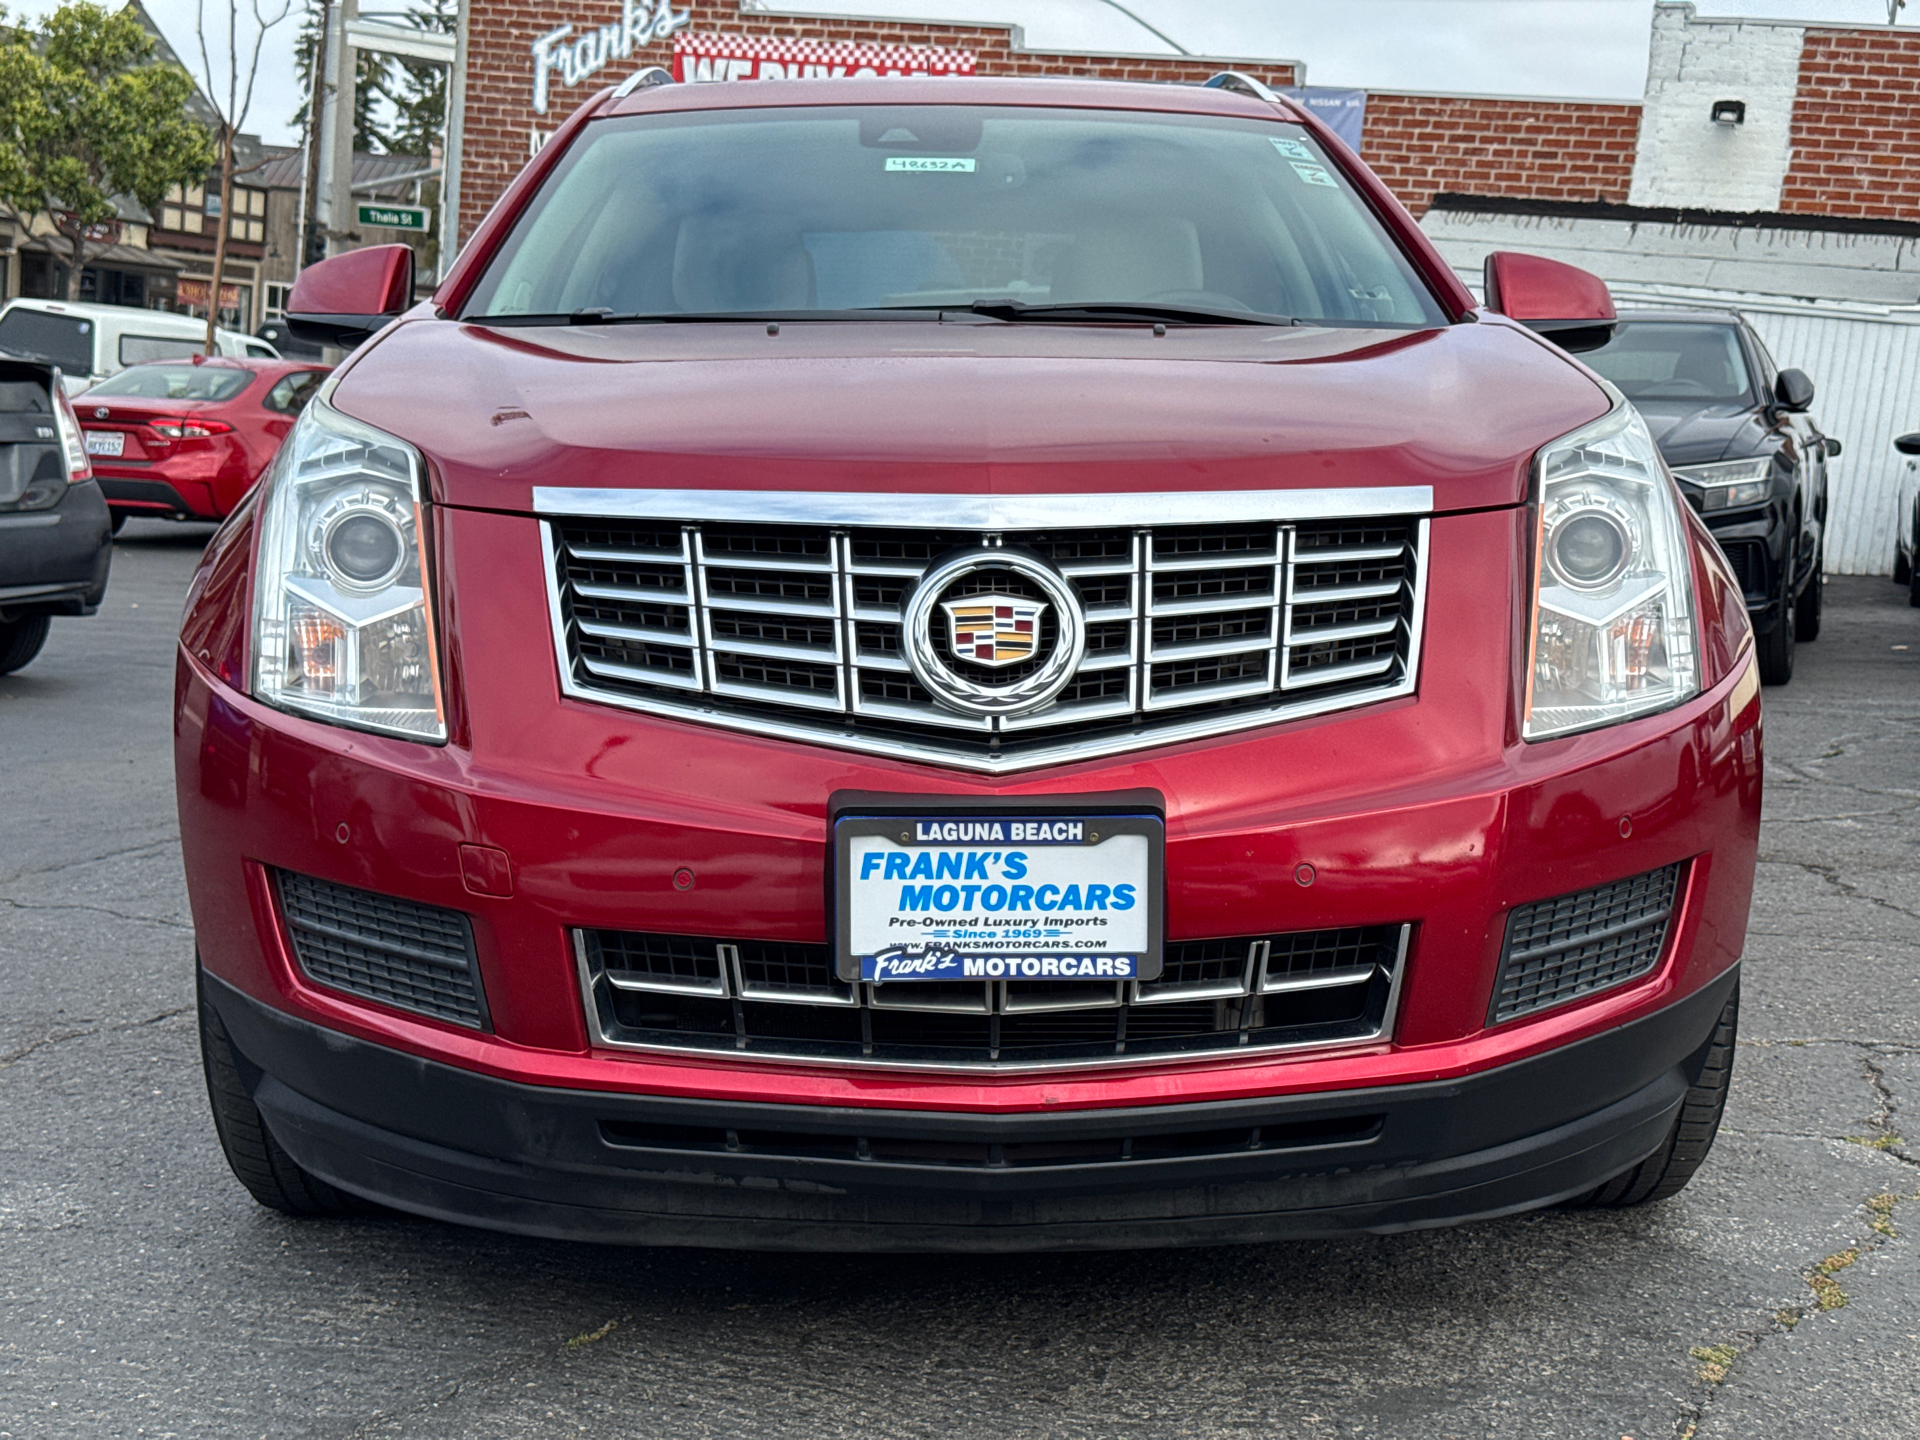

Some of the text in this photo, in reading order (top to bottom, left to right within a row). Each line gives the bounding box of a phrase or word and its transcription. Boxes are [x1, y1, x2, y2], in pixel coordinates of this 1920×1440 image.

[400, 213, 413, 226] St
[916, 822, 1083, 841] LAGUNA BEACH
[860, 851, 1028, 880] FRANK'S
[898, 883, 1137, 912] MOTORCARS
[888, 915, 1109, 929] Pre-Owned Luxury Imports
[951, 929, 1043, 939] Since 1969
[963, 957, 1131, 977] MOTORCARS
